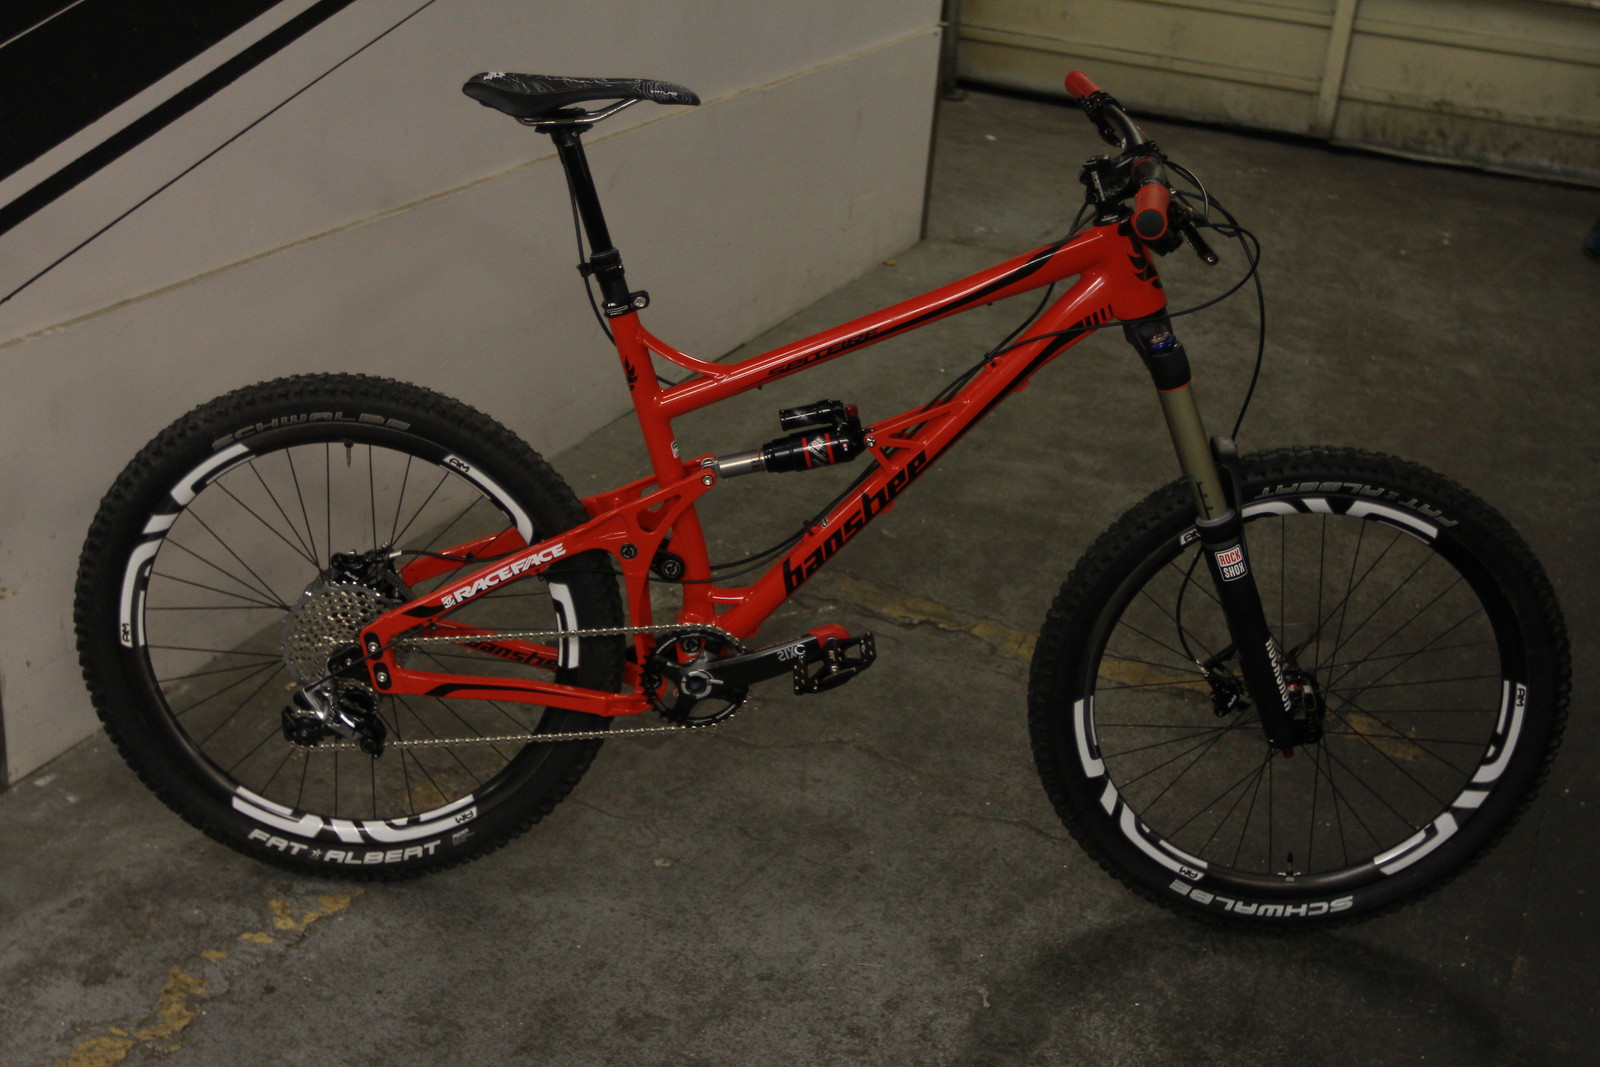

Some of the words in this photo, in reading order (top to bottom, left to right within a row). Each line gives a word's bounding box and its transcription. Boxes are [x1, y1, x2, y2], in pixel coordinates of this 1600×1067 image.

[783, 450, 927, 597] banshee
[1218, 549, 1241, 566] ROCK
[1223, 562, 1246, 579] SHOX
[248, 828, 308, 856] FAT
[323, 840, 441, 865] ALBERT
[1169, 878, 1354, 918] SCHWALBE
